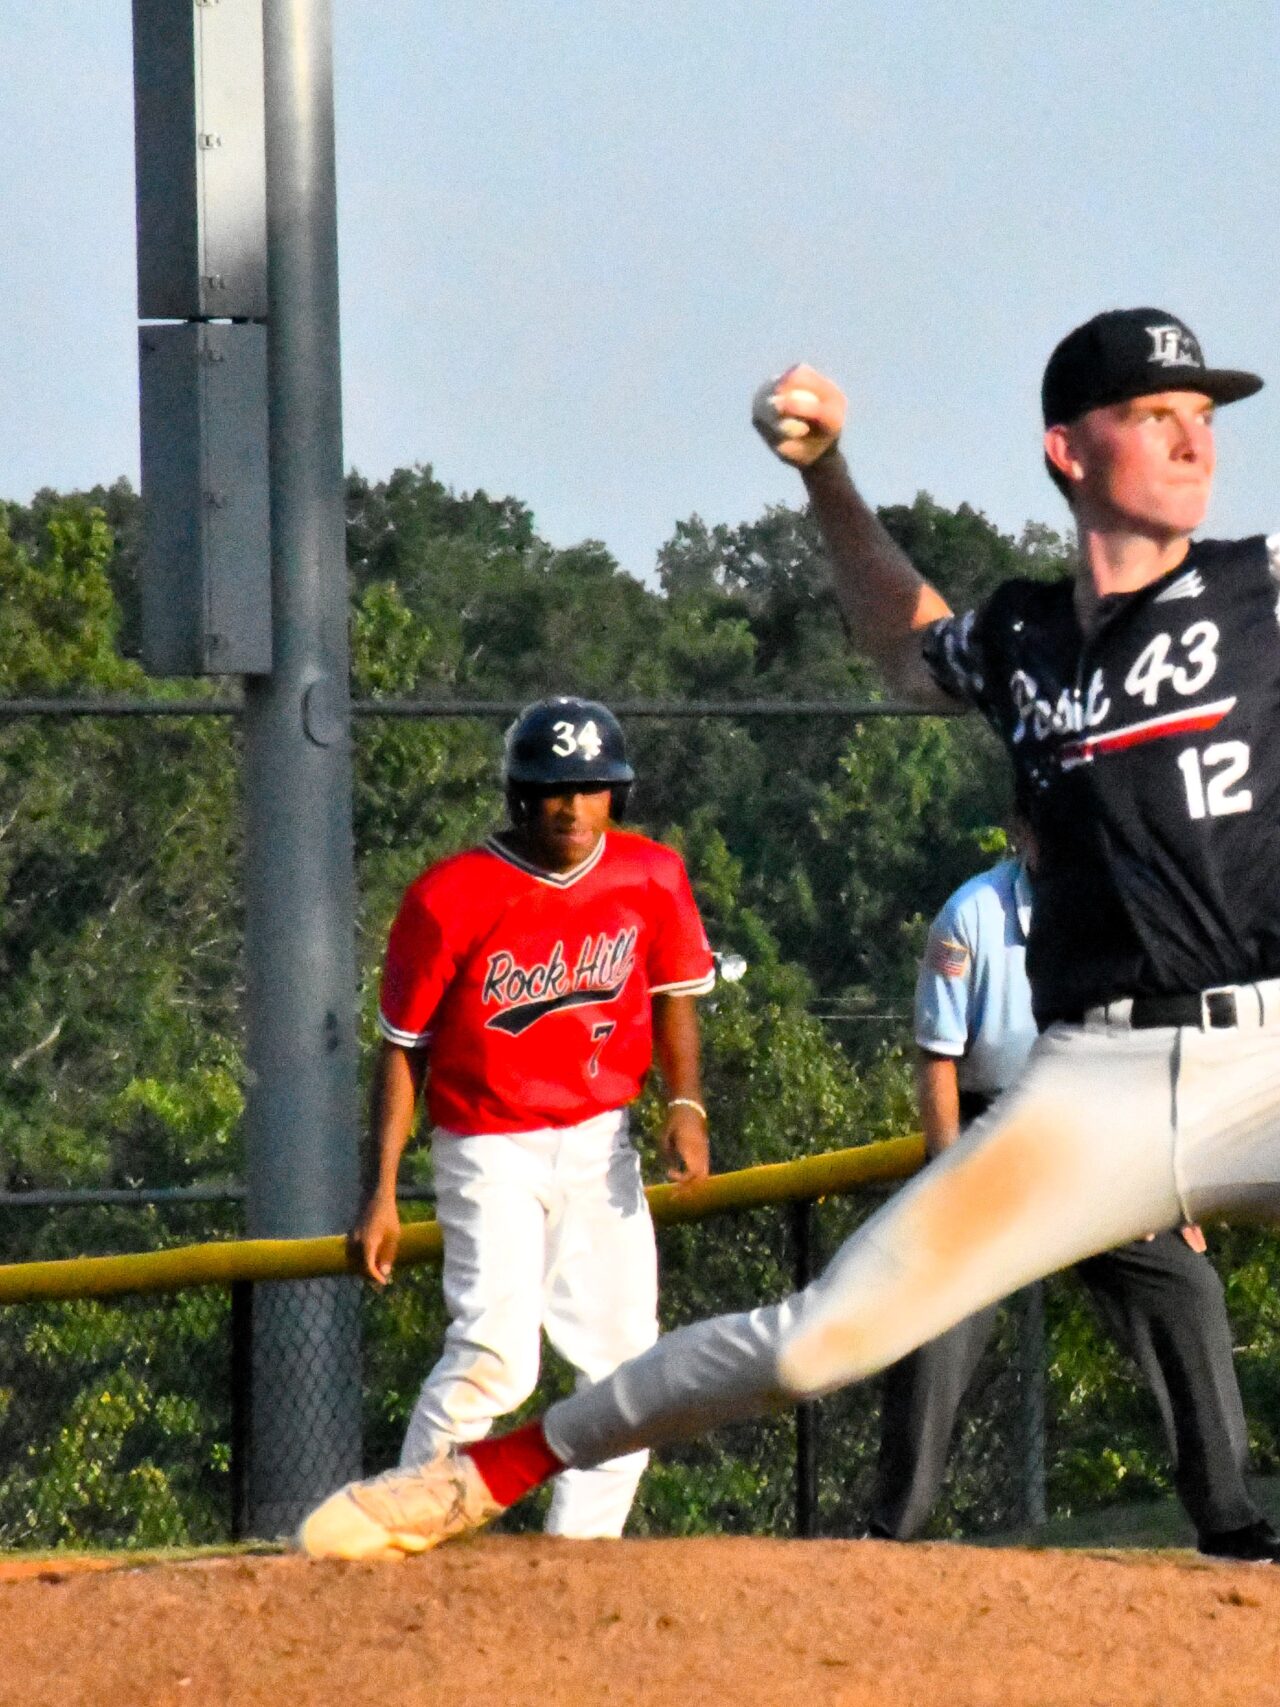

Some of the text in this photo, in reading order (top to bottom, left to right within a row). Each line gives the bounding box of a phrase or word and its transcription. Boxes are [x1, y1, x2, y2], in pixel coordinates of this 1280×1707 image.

[1124, 620, 1220, 707] 43
[551, 720, 603, 761] 34
[1176, 739, 1253, 820] 12
[482, 925, 638, 1005] Rock Hill
[589, 1020, 617, 1078] 7
